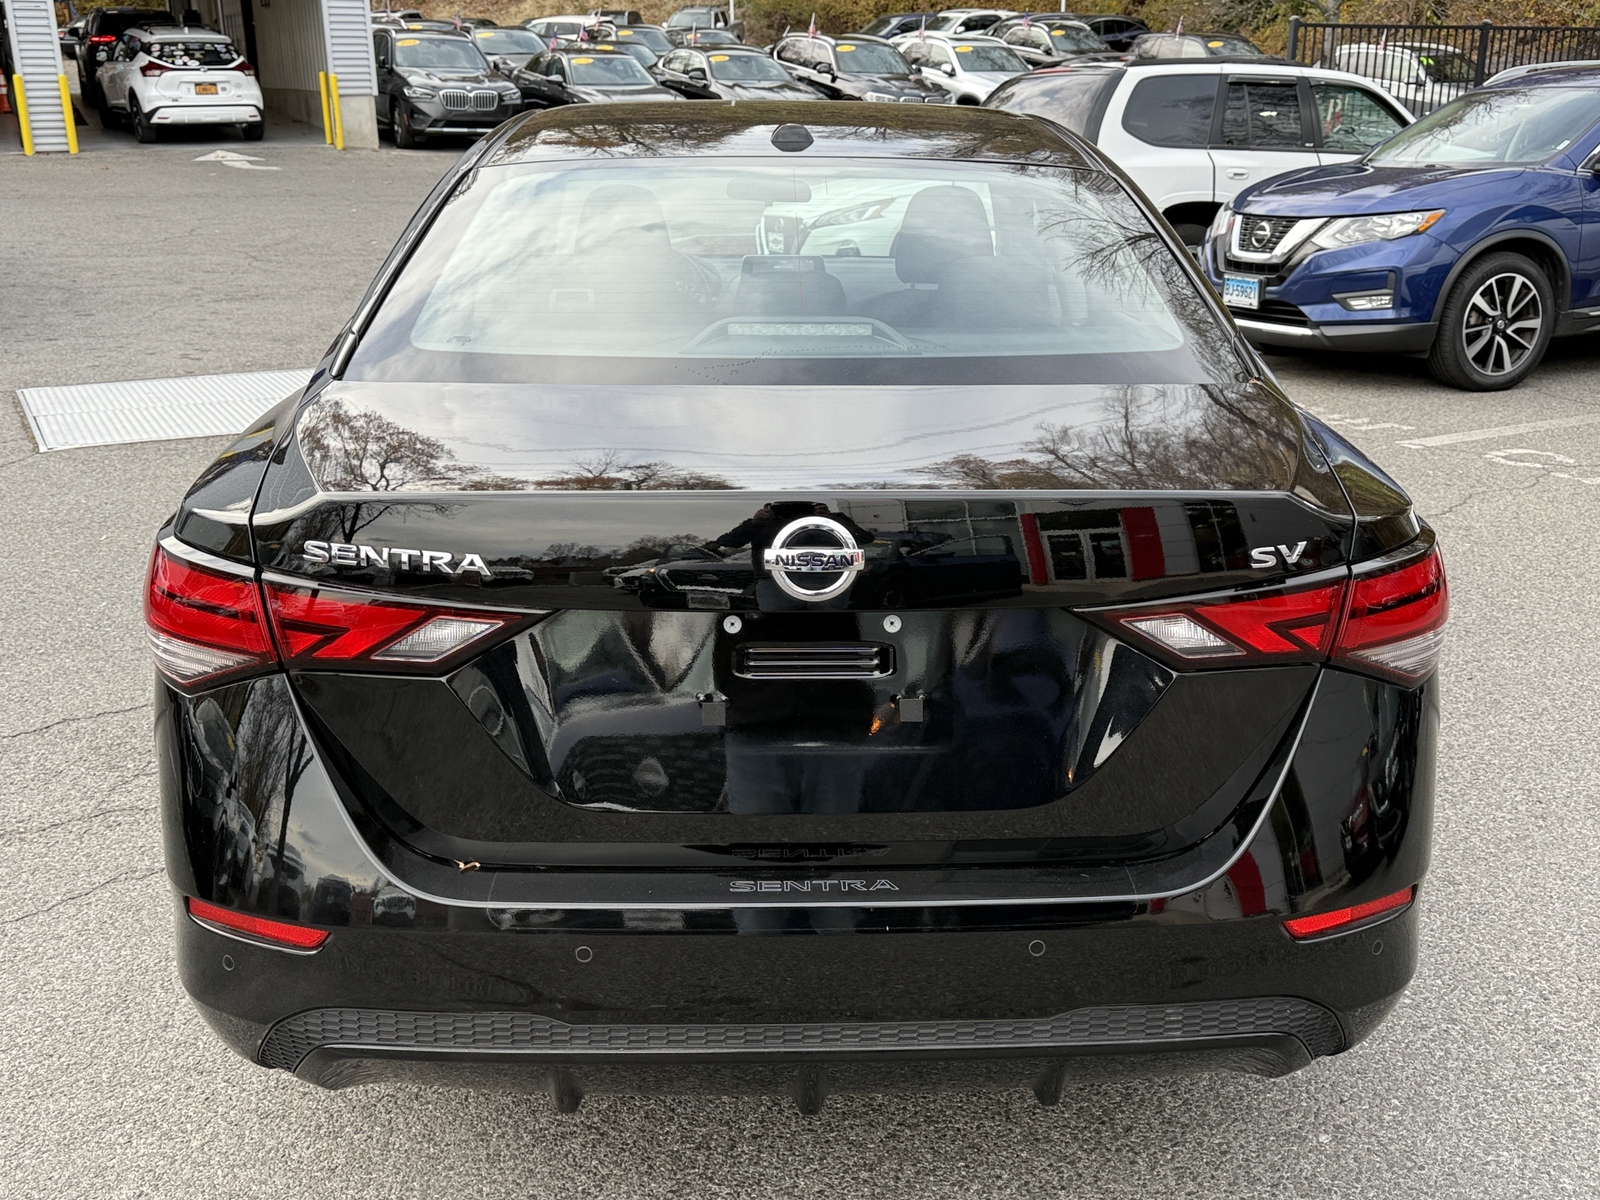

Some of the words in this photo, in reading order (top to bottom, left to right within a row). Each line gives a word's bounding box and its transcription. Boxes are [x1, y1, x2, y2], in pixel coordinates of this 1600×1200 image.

[303, 540, 491, 576] SENTRA
[775, 554, 855, 567] NISSAN
[1250, 541, 1308, 569] SV
[729, 879, 900, 893] SENTRA
